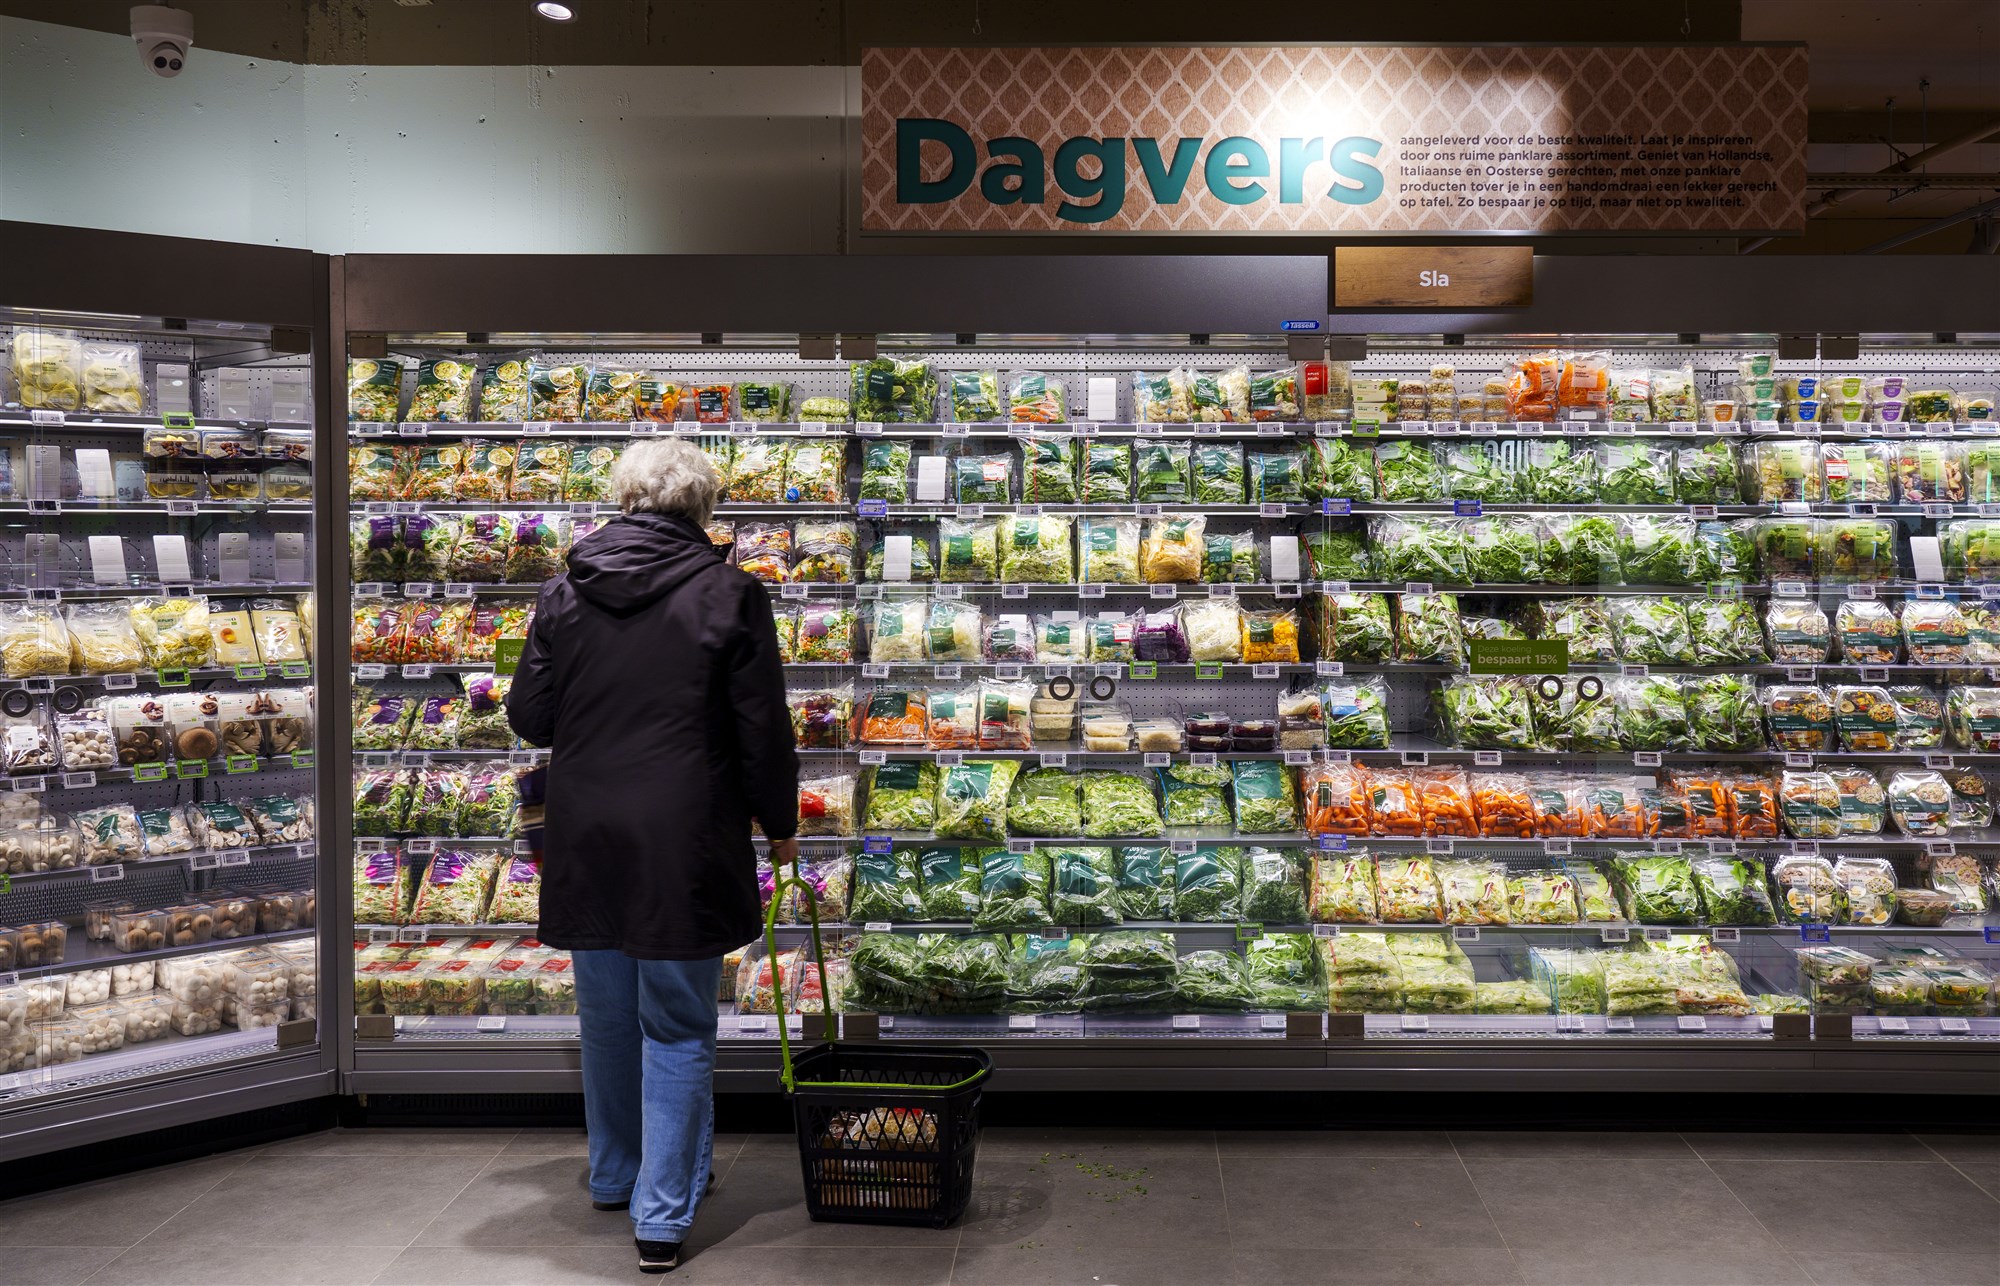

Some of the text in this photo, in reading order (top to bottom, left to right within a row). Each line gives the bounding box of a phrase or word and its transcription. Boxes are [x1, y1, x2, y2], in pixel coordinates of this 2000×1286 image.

[1400, 135, 1753, 147] aangeleverd voor de beste kwaliteit. Laat je inspireren
[1400, 150, 1429, 160] door
[1460, 151, 1495, 160] ruime
[1499, 150, 1553, 162] panklare
[1557, 151, 1633, 160] assortiment.
[1638, 151, 1679, 160] Geniet
[1709, 150, 1774, 162] Hollandse,
[896, 117, 1384, 223] Dagvers
[1400, 166, 1741, 178] Italiaanse en Oosterse gerechten, met onze panklare
[1400, 181, 1466, 193] producten
[1471, 182, 1504, 191] tover
[1508, 181, 1519, 193] je
[1524, 181, 1535, 191] in
[1567, 181, 1651, 191] handomdraai
[1684, 181, 1723, 191] lekker
[1728, 181, 1777, 193] gerecht
[1400, 199, 1416, 208] op
[1421, 197, 1453, 206] tafel.
[1458, 197, 1474, 206] Zo
[1479, 197, 1530, 208] bespaar
[1534, 197, 1545, 208] je
[1549, 199, 1566, 208] op
[1571, 197, 1596, 208] tijd,
[1636, 197, 1660, 206] niet
[1665, 199, 1682, 208] op
[1686, 197, 1745, 206] kwaliteit.
[1419, 271, 1449, 287] Sla
[1478, 645, 1532, 654] Deze koeling
[1478, 654, 1558, 666] bespaart 15%
